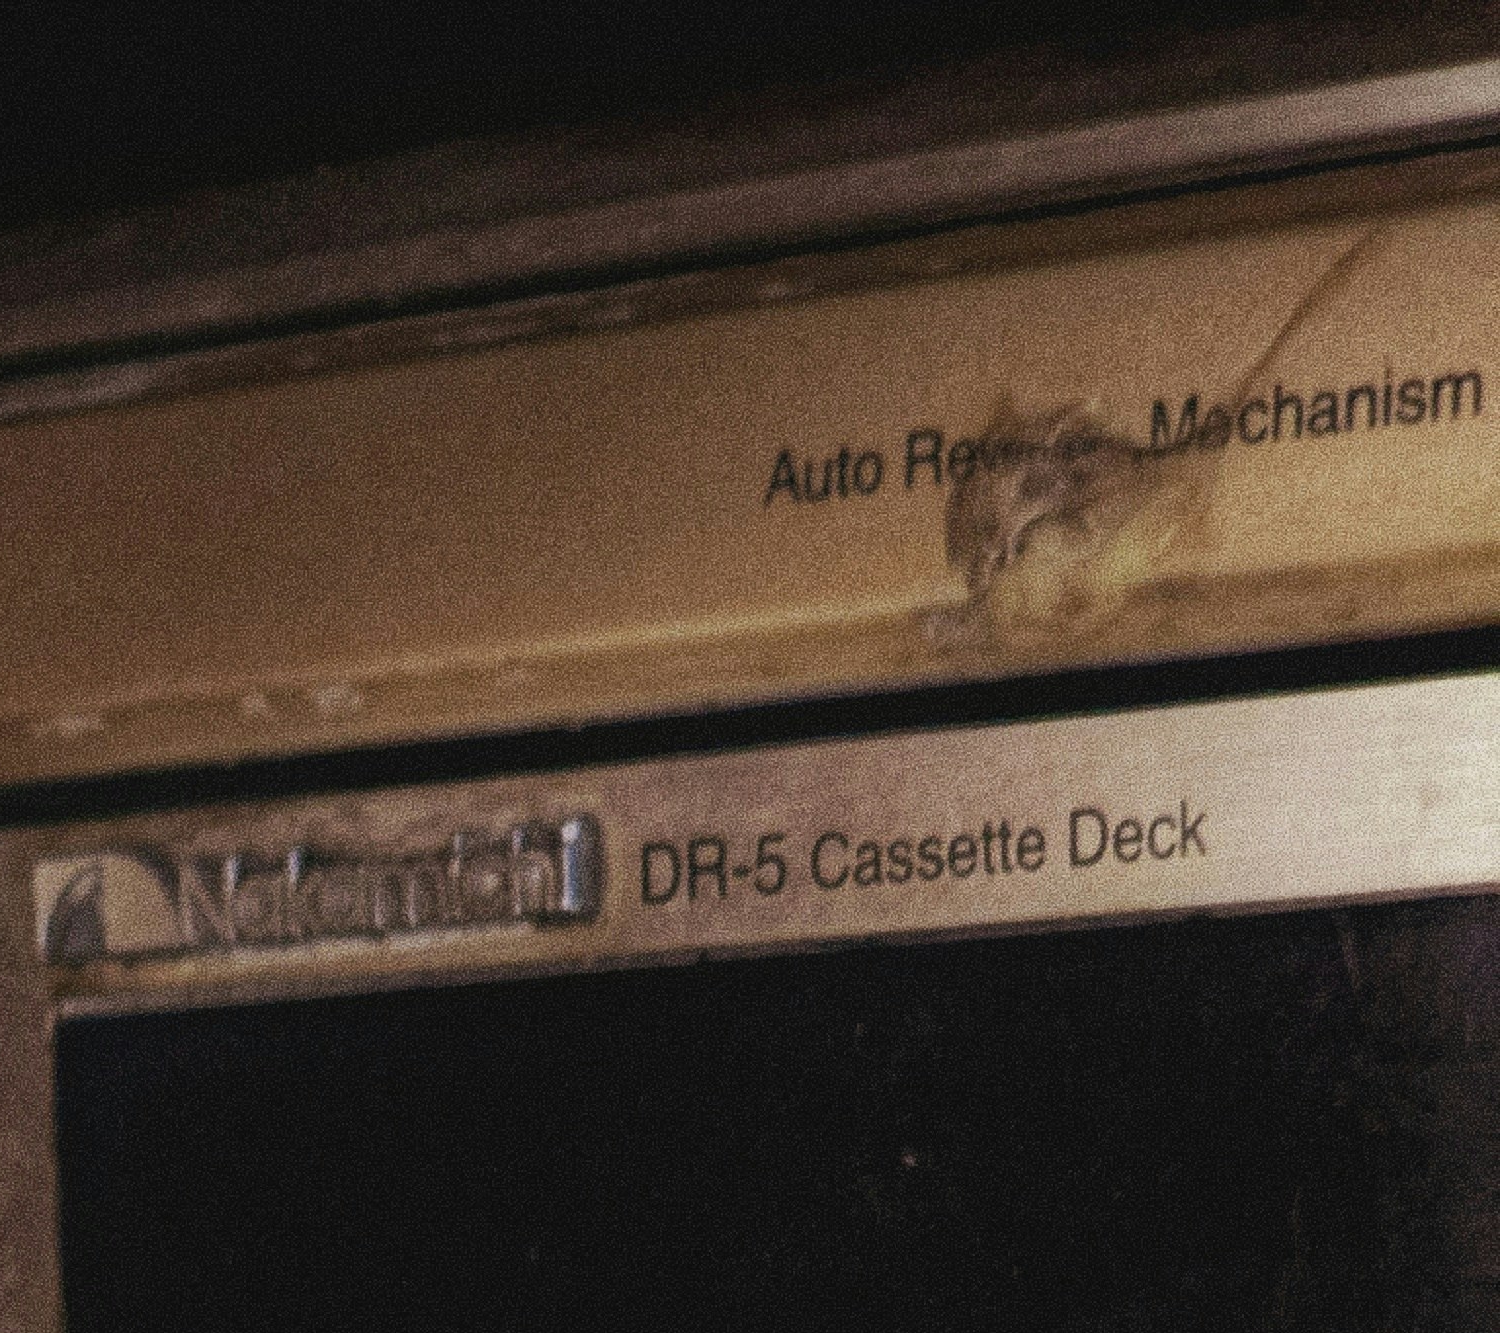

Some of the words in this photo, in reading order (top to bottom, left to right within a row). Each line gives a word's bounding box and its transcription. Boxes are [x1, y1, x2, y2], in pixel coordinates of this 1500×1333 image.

[764, 446, 884, 506] Auto
[640, 832, 787, 906] DR-5
[809, 819, 1046, 890] Cassette
[1068, 799, 1208, 869] Deck
